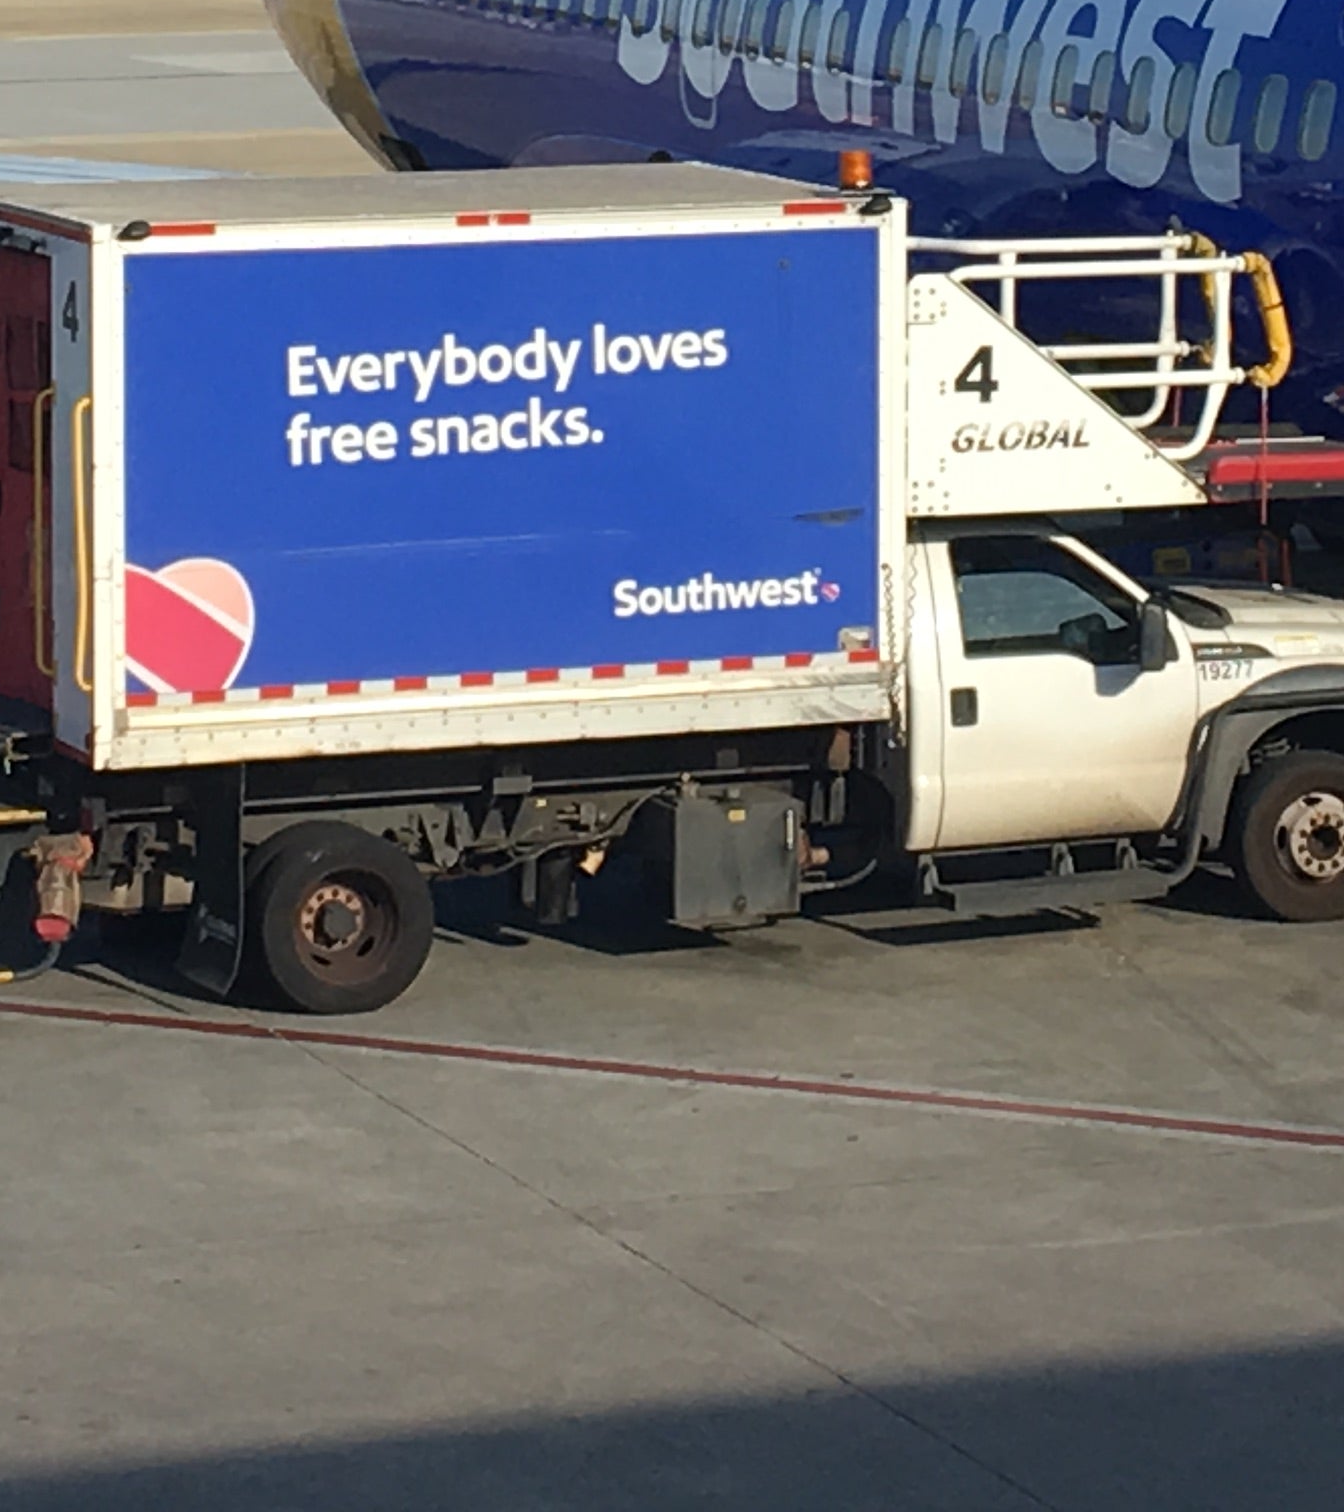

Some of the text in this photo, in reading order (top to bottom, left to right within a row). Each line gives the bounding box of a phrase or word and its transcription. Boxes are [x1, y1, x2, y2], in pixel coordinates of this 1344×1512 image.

[62, 279, 80, 343] 4
[287, 323, 728, 402] Everybody loves
[954, 345, 999, 404] 4
[286, 396, 604, 466] free snacks.
[951, 418, 1089, 453] GLOBAL
[613, 570, 819, 617] Southwest
[1199, 658, 1254, 681] 19277
